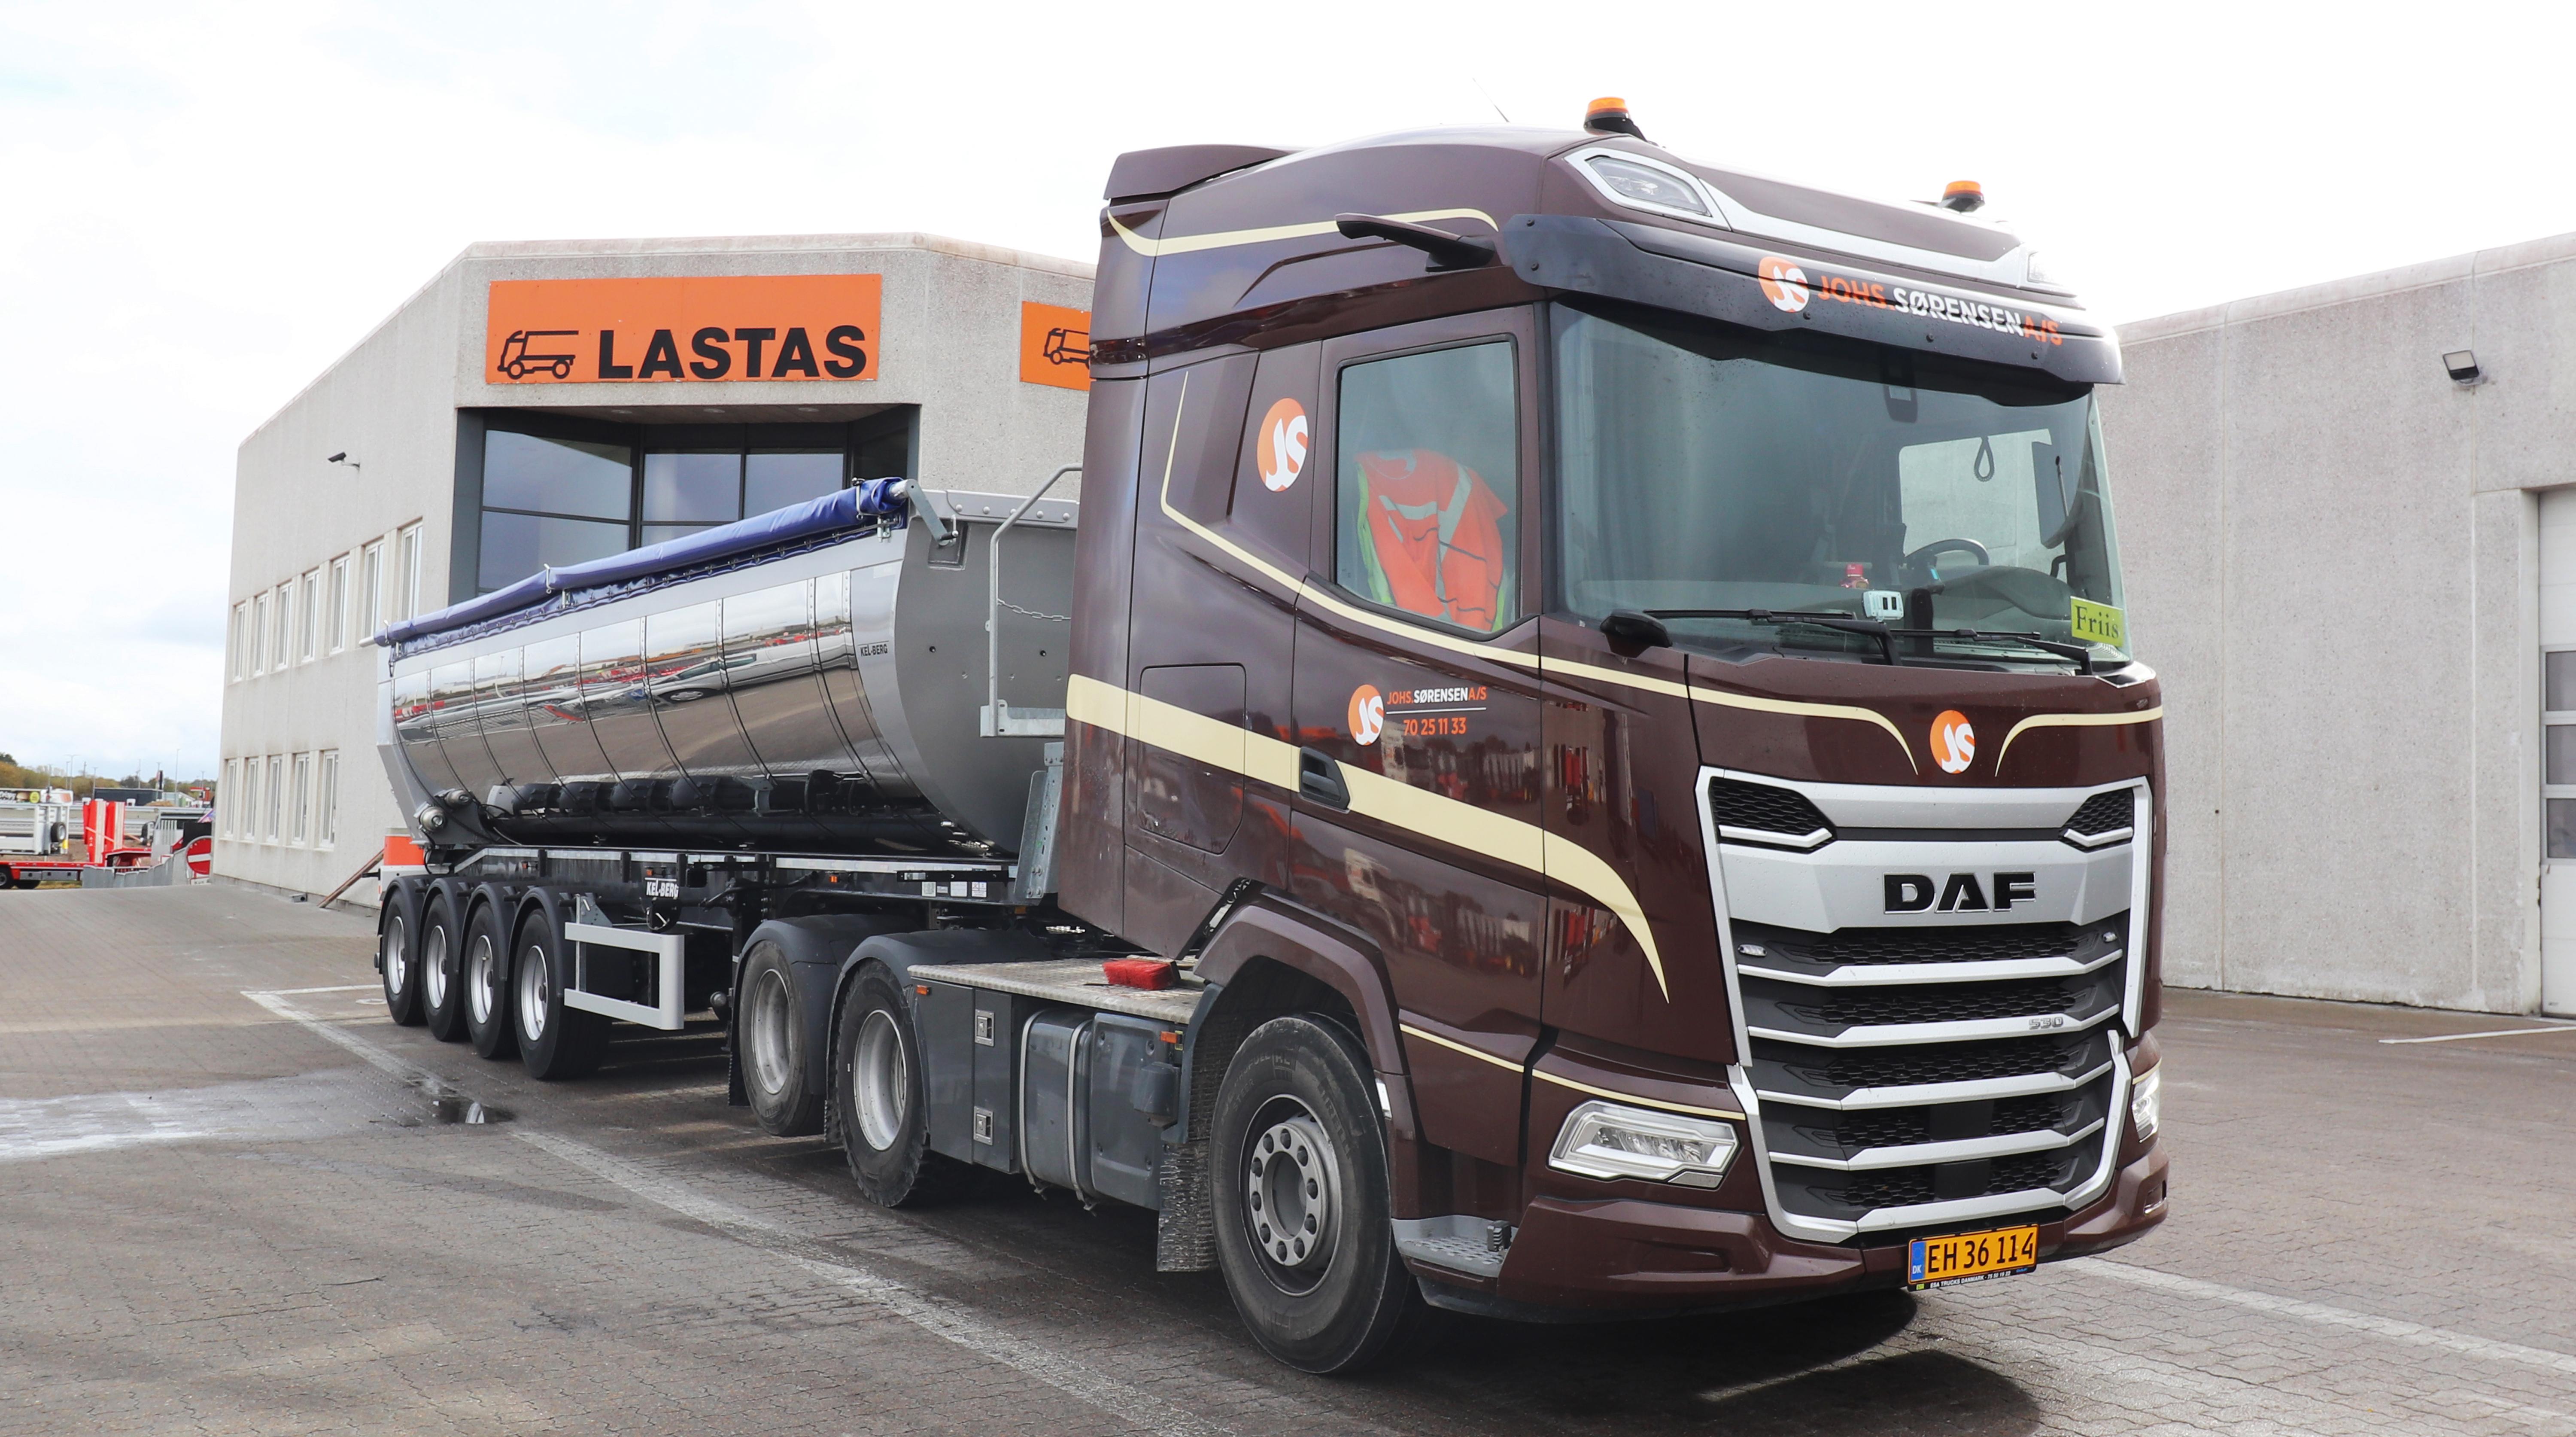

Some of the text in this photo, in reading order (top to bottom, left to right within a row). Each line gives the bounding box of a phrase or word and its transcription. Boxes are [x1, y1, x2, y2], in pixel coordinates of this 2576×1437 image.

[1893, 287, 2025, 337] SØRENSEN
[598, 325, 866, 379] LASTAS
[2075, 605, 2119, 639] Friis
[860, 643, 888, 657] KEL-BERG
[1387, 686, 1487, 705] JOHS. SØRENSEN A/S
[1403, 717, 1467, 736] 70 25 11 33
[646, 879, 679, 898] KEL-BERG
[1883, 871, 2036, 914] DAF
[2029, 1016, 2063, 1030] 530
[1928, 1232, 2034, 1273] EH 36 114
[1912, 1264, 1922, 1274] DK
[1941, 1279, 1960, 1287] TRUCKS
[1961, 1275, 1985, 1284] DANMARK
